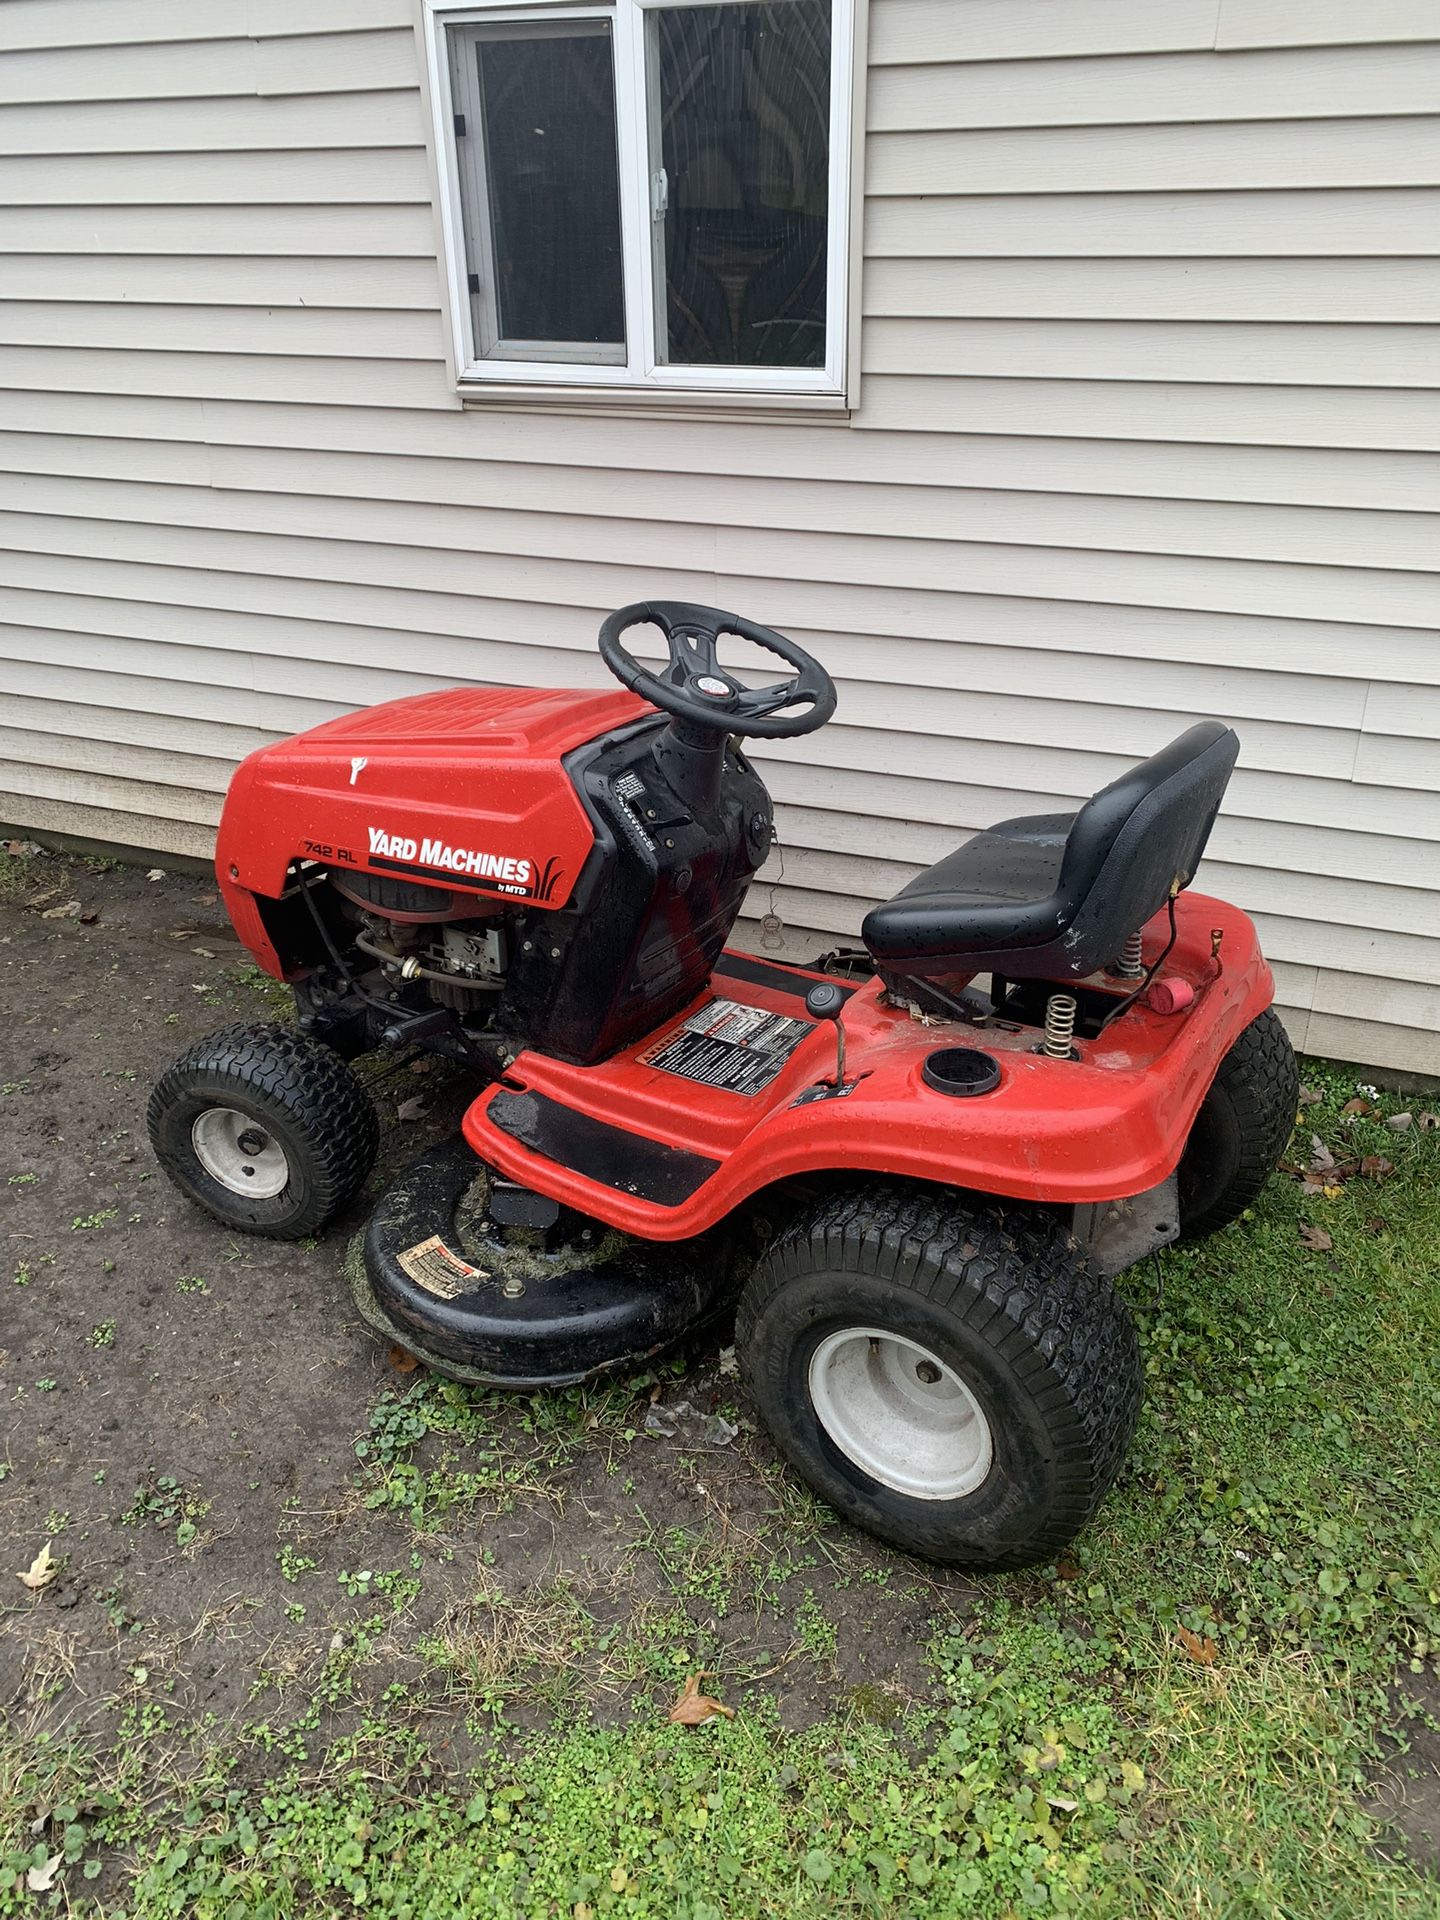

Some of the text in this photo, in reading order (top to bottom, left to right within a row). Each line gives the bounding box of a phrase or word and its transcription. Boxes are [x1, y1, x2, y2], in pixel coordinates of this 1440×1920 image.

[303, 841, 358, 863] 742 RL
[367, 826, 531, 883] YARD MACHINES
[497, 883, 527, 896] by MTD
[650, 1029, 685, 1055] WARNING
